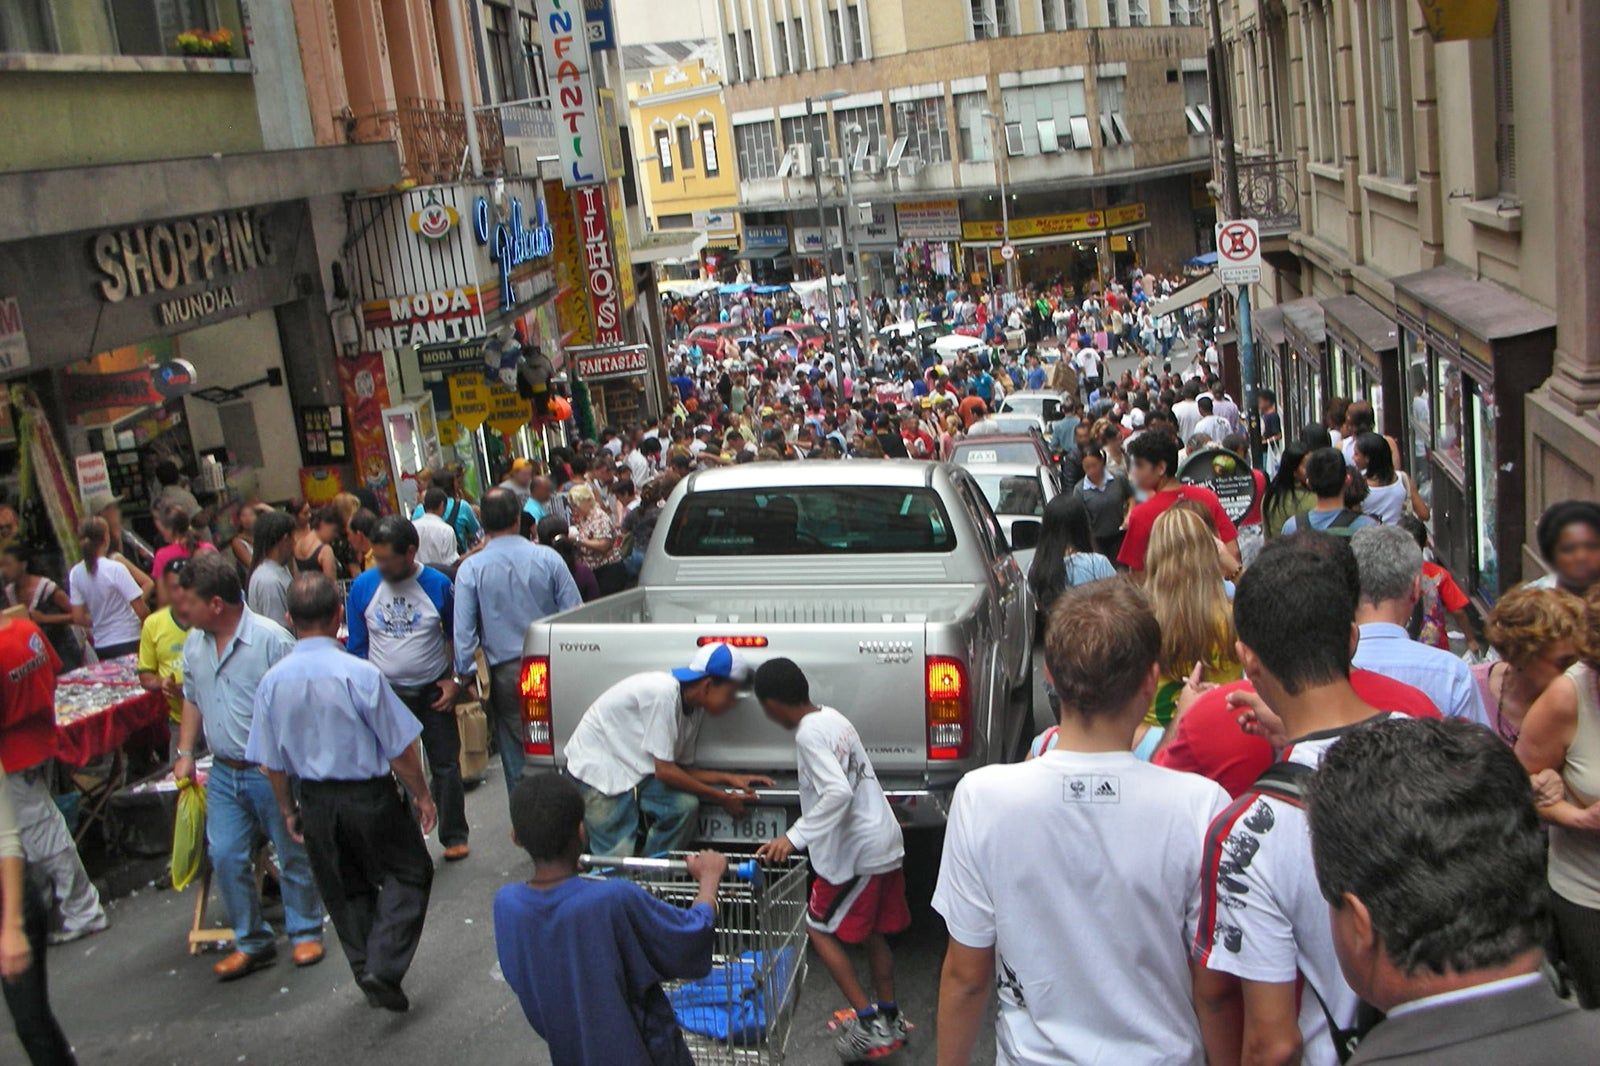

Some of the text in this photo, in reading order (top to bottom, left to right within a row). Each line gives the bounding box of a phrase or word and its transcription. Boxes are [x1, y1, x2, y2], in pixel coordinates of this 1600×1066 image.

[160, 285, 241, 326] MUNDIAL
[389, 289, 472, 321] MODA
[366, 313, 488, 351] INFANTIL
[422, 349, 454, 365] MODA
[578, 353, 647, 375] FANTASIAS
[559, 643, 601, 652] TOYOTA
